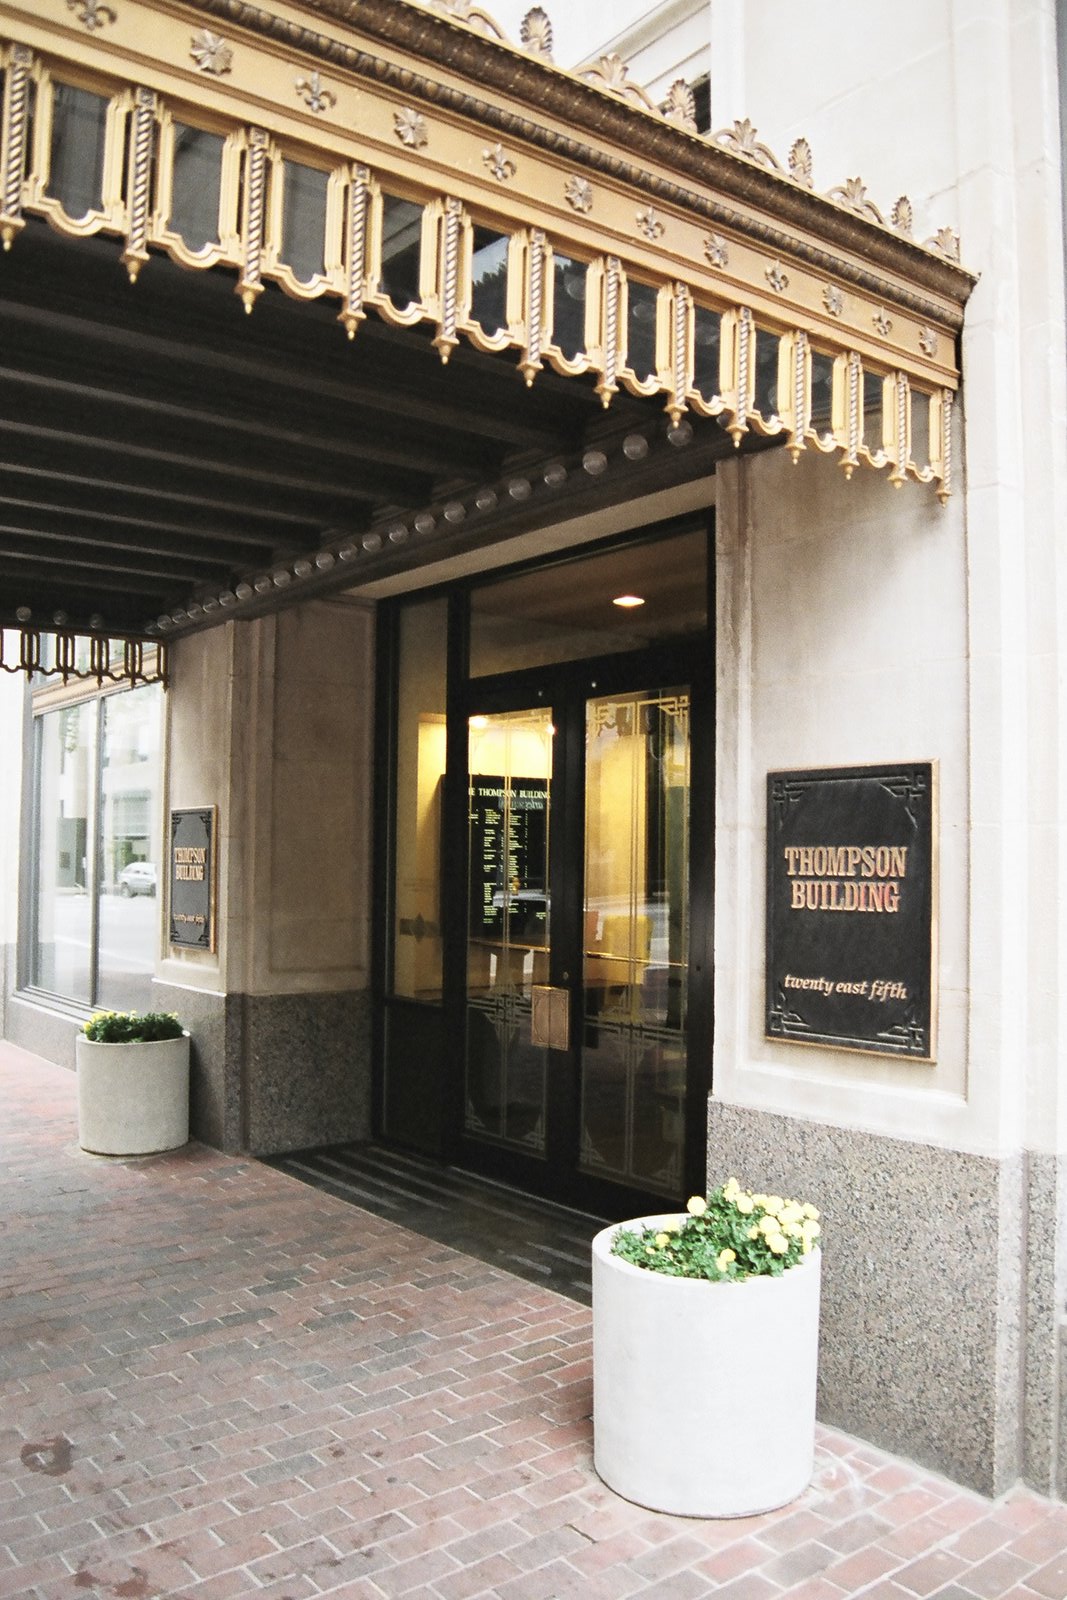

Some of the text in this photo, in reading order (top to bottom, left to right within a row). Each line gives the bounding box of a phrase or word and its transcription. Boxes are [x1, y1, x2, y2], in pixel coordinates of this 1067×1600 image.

[784, 846, 908, 877] THOMPSON
[791, 880, 901, 913] BUILDING
[784, 974, 908, 1002] twenty east fifth
